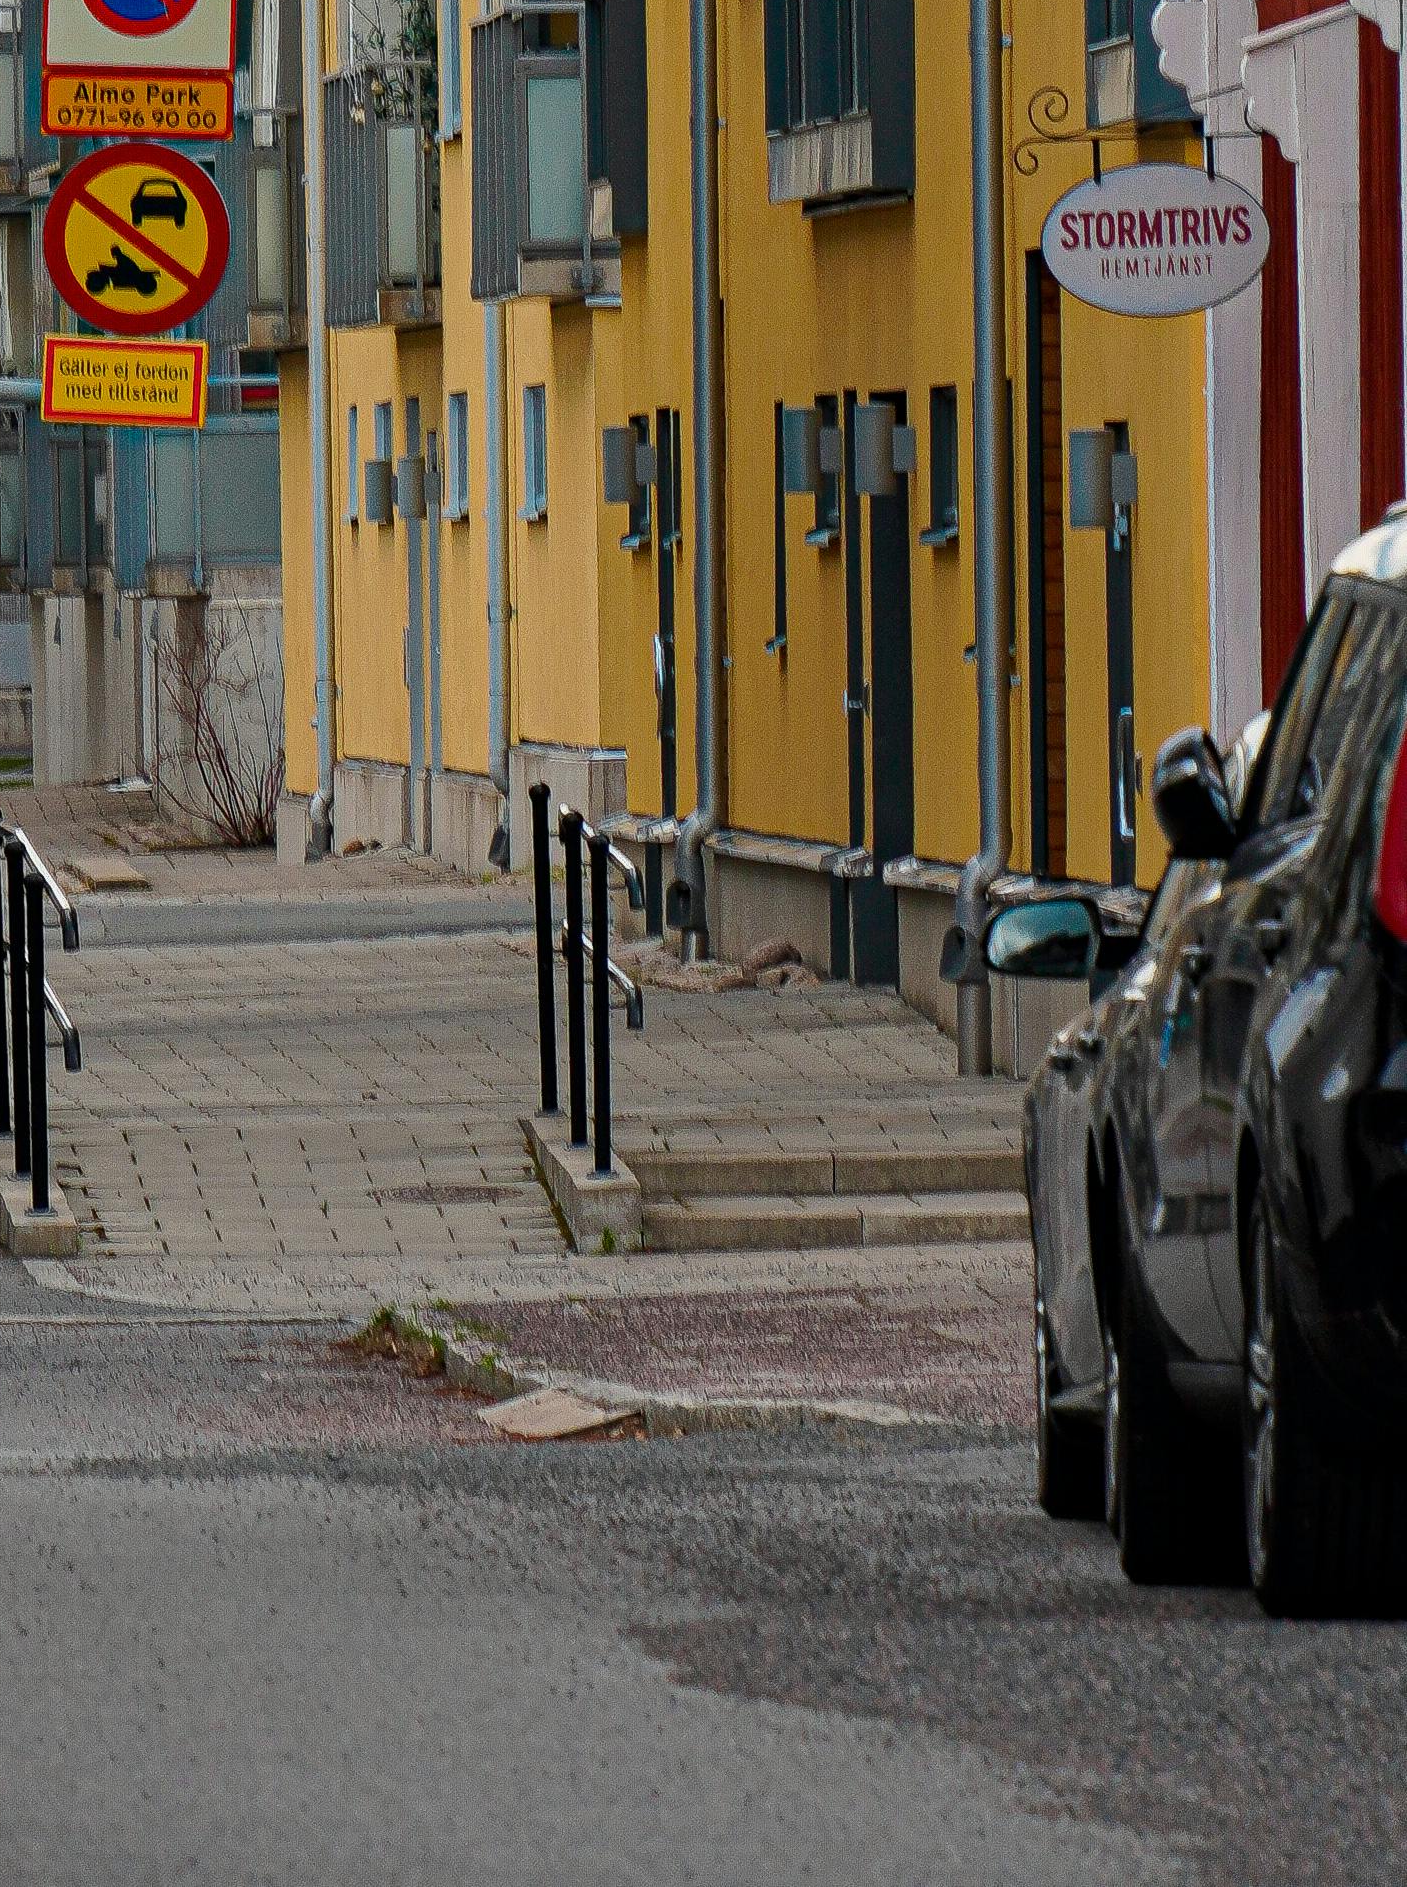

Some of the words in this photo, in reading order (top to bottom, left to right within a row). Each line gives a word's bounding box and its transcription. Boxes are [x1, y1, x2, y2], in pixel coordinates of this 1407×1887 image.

[146, 83, 201, 107] Park
[57, 105, 145, 127] 0771-96
[151, 106, 180, 129] 90
[186, 108, 218, 130] 00
[1060, 204, 1252, 252] STORMTRIVS
[1101, 253, 1213, 280] HEMTJÄNST
[59, 355, 109, 378] Gäller
[113, 358, 130, 382] ej
[135, 361, 189, 382] fordon
[65, 382, 102, 401] med
[108, 382, 180, 404] tillstånd
